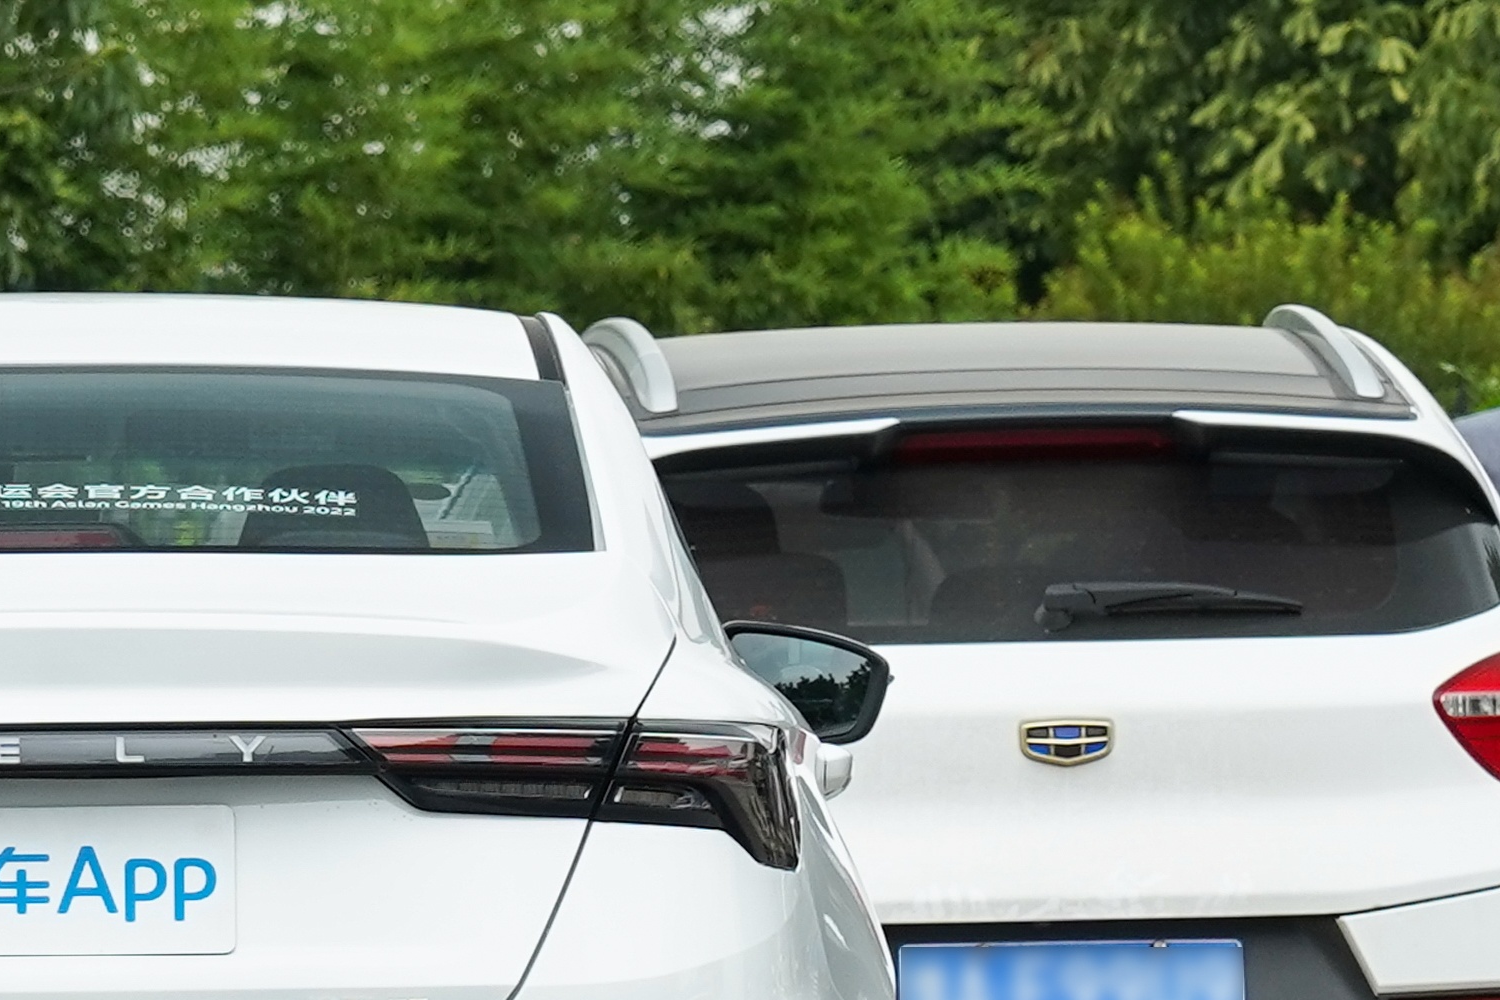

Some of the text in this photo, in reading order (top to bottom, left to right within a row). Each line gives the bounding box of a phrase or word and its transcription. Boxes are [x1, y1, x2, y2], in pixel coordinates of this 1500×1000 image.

[2, 500, 48, 509] 19th
[51, 500, 111, 509] Asian
[114, 500, 187, 510] Games
[191, 501, 298, 513] Hangzhou
[302, 506, 357, 516] 2022
